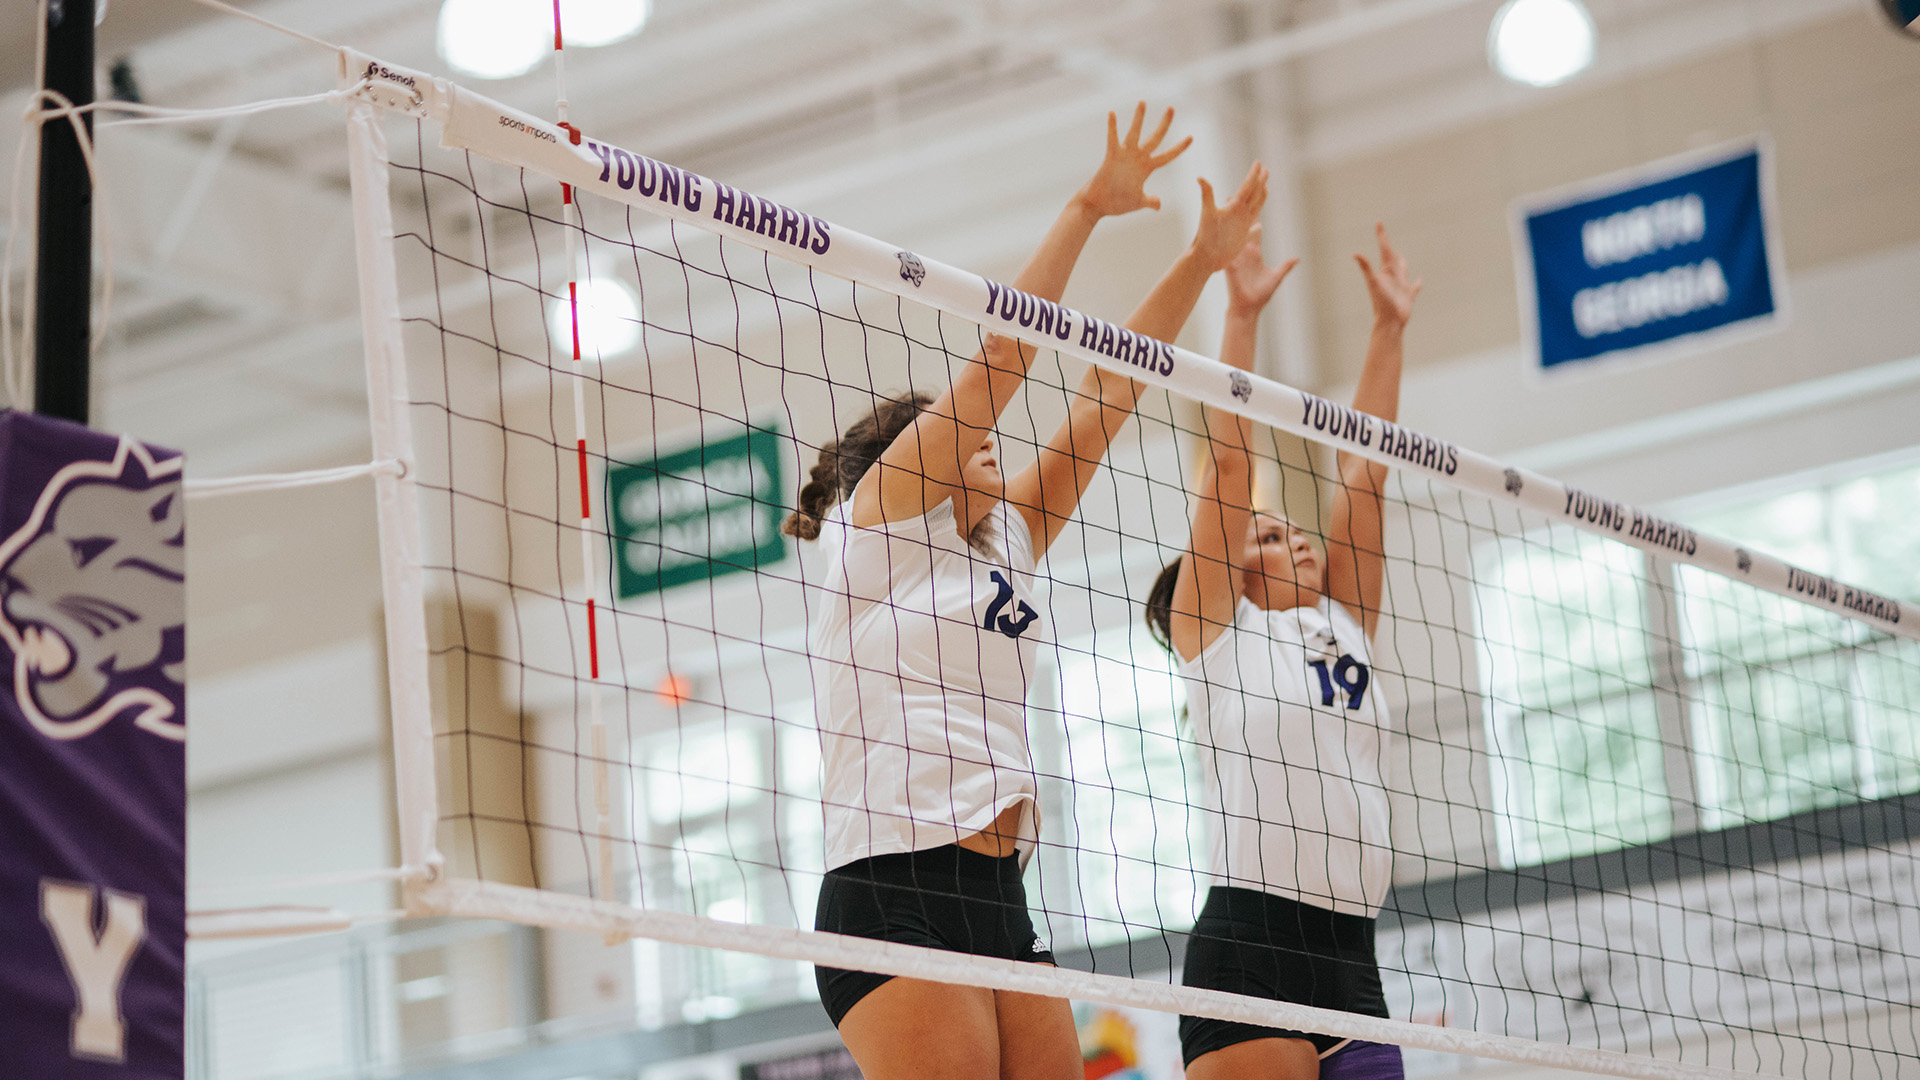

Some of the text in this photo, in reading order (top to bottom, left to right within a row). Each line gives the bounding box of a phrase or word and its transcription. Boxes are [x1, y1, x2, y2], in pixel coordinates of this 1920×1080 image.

[379, 67, 416, 88] Senoh
[588, 142, 831, 255] YOUNG HARRIS
[983, 277, 1175, 377] YOUNG HARRIS
[1301, 392, 1458, 476] YOUNG HARRIS
[1564, 485, 1697, 557] YOUNG HARRIS
[1787, 565, 1900, 624] YOUNG HARRIS
[1307, 654, 1369, 711] 19
[40, 878, 147, 1063] Y
